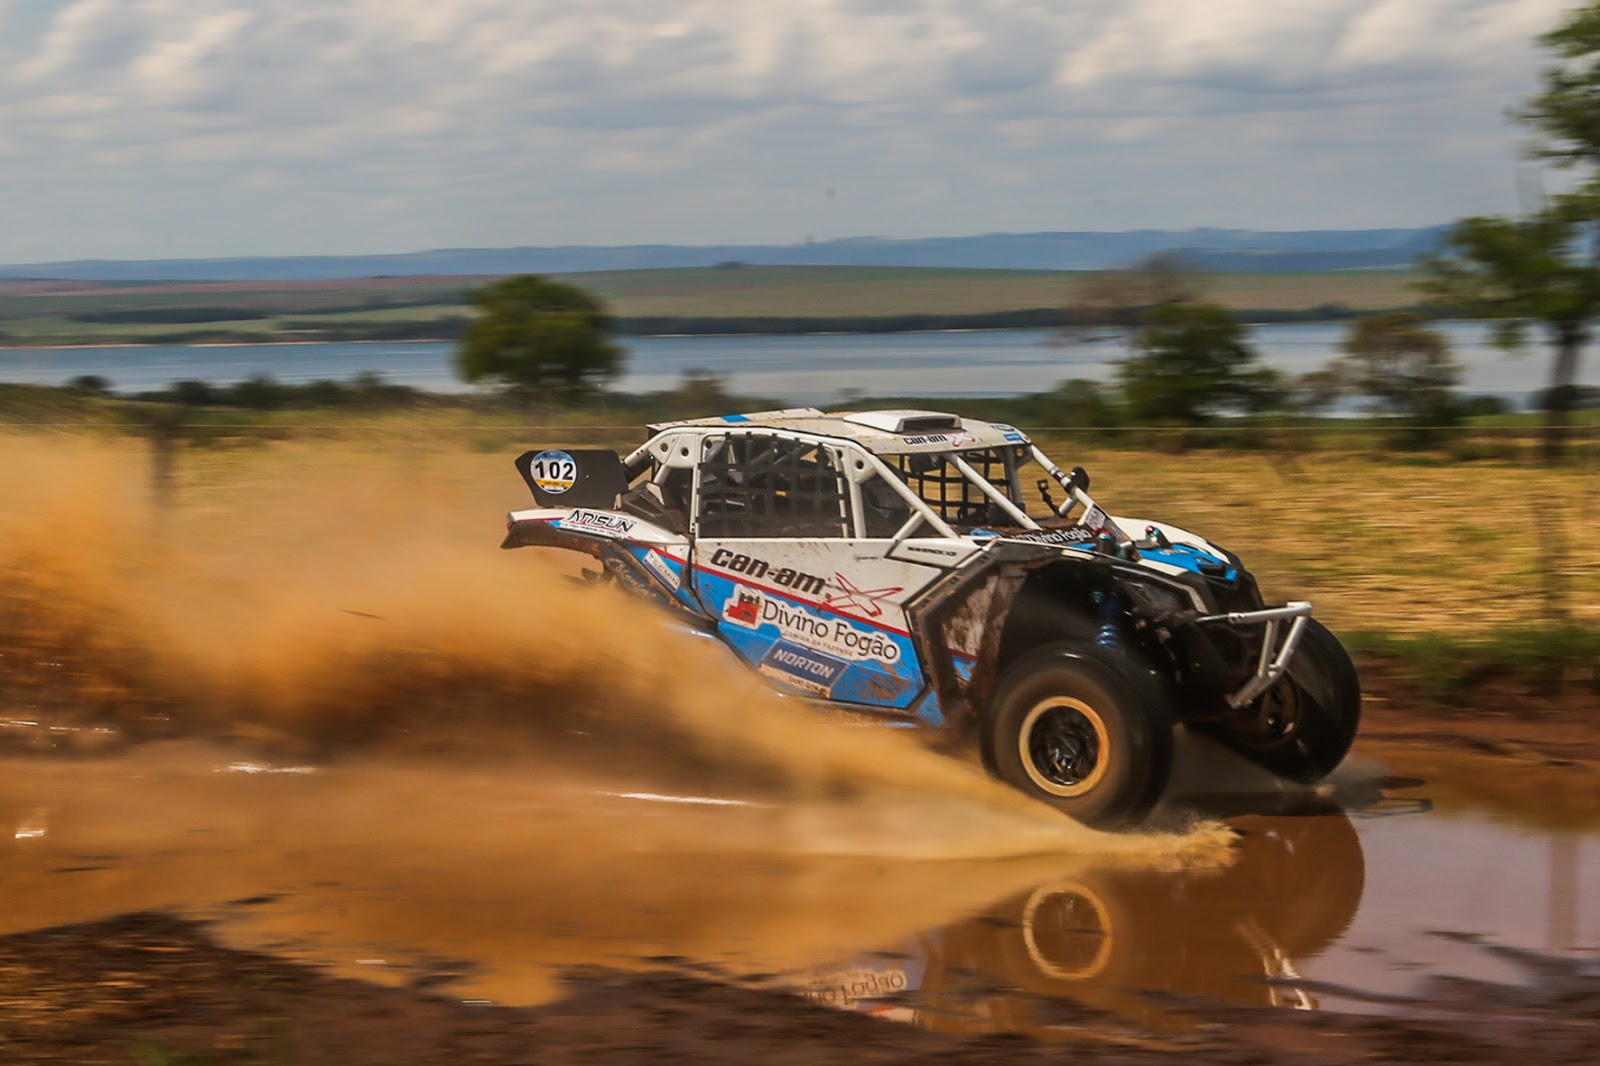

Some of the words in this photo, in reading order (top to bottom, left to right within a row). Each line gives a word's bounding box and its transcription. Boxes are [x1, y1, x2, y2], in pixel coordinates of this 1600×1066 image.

[534, 460, 574, 481] 102
[567, 509, 635, 533] ARISUN
[710, 548, 825, 596] can-am
[762, 599, 829, 638] Divino
[833, 622, 898, 661] Fogão
[773, 648, 835, 679] NORTON
